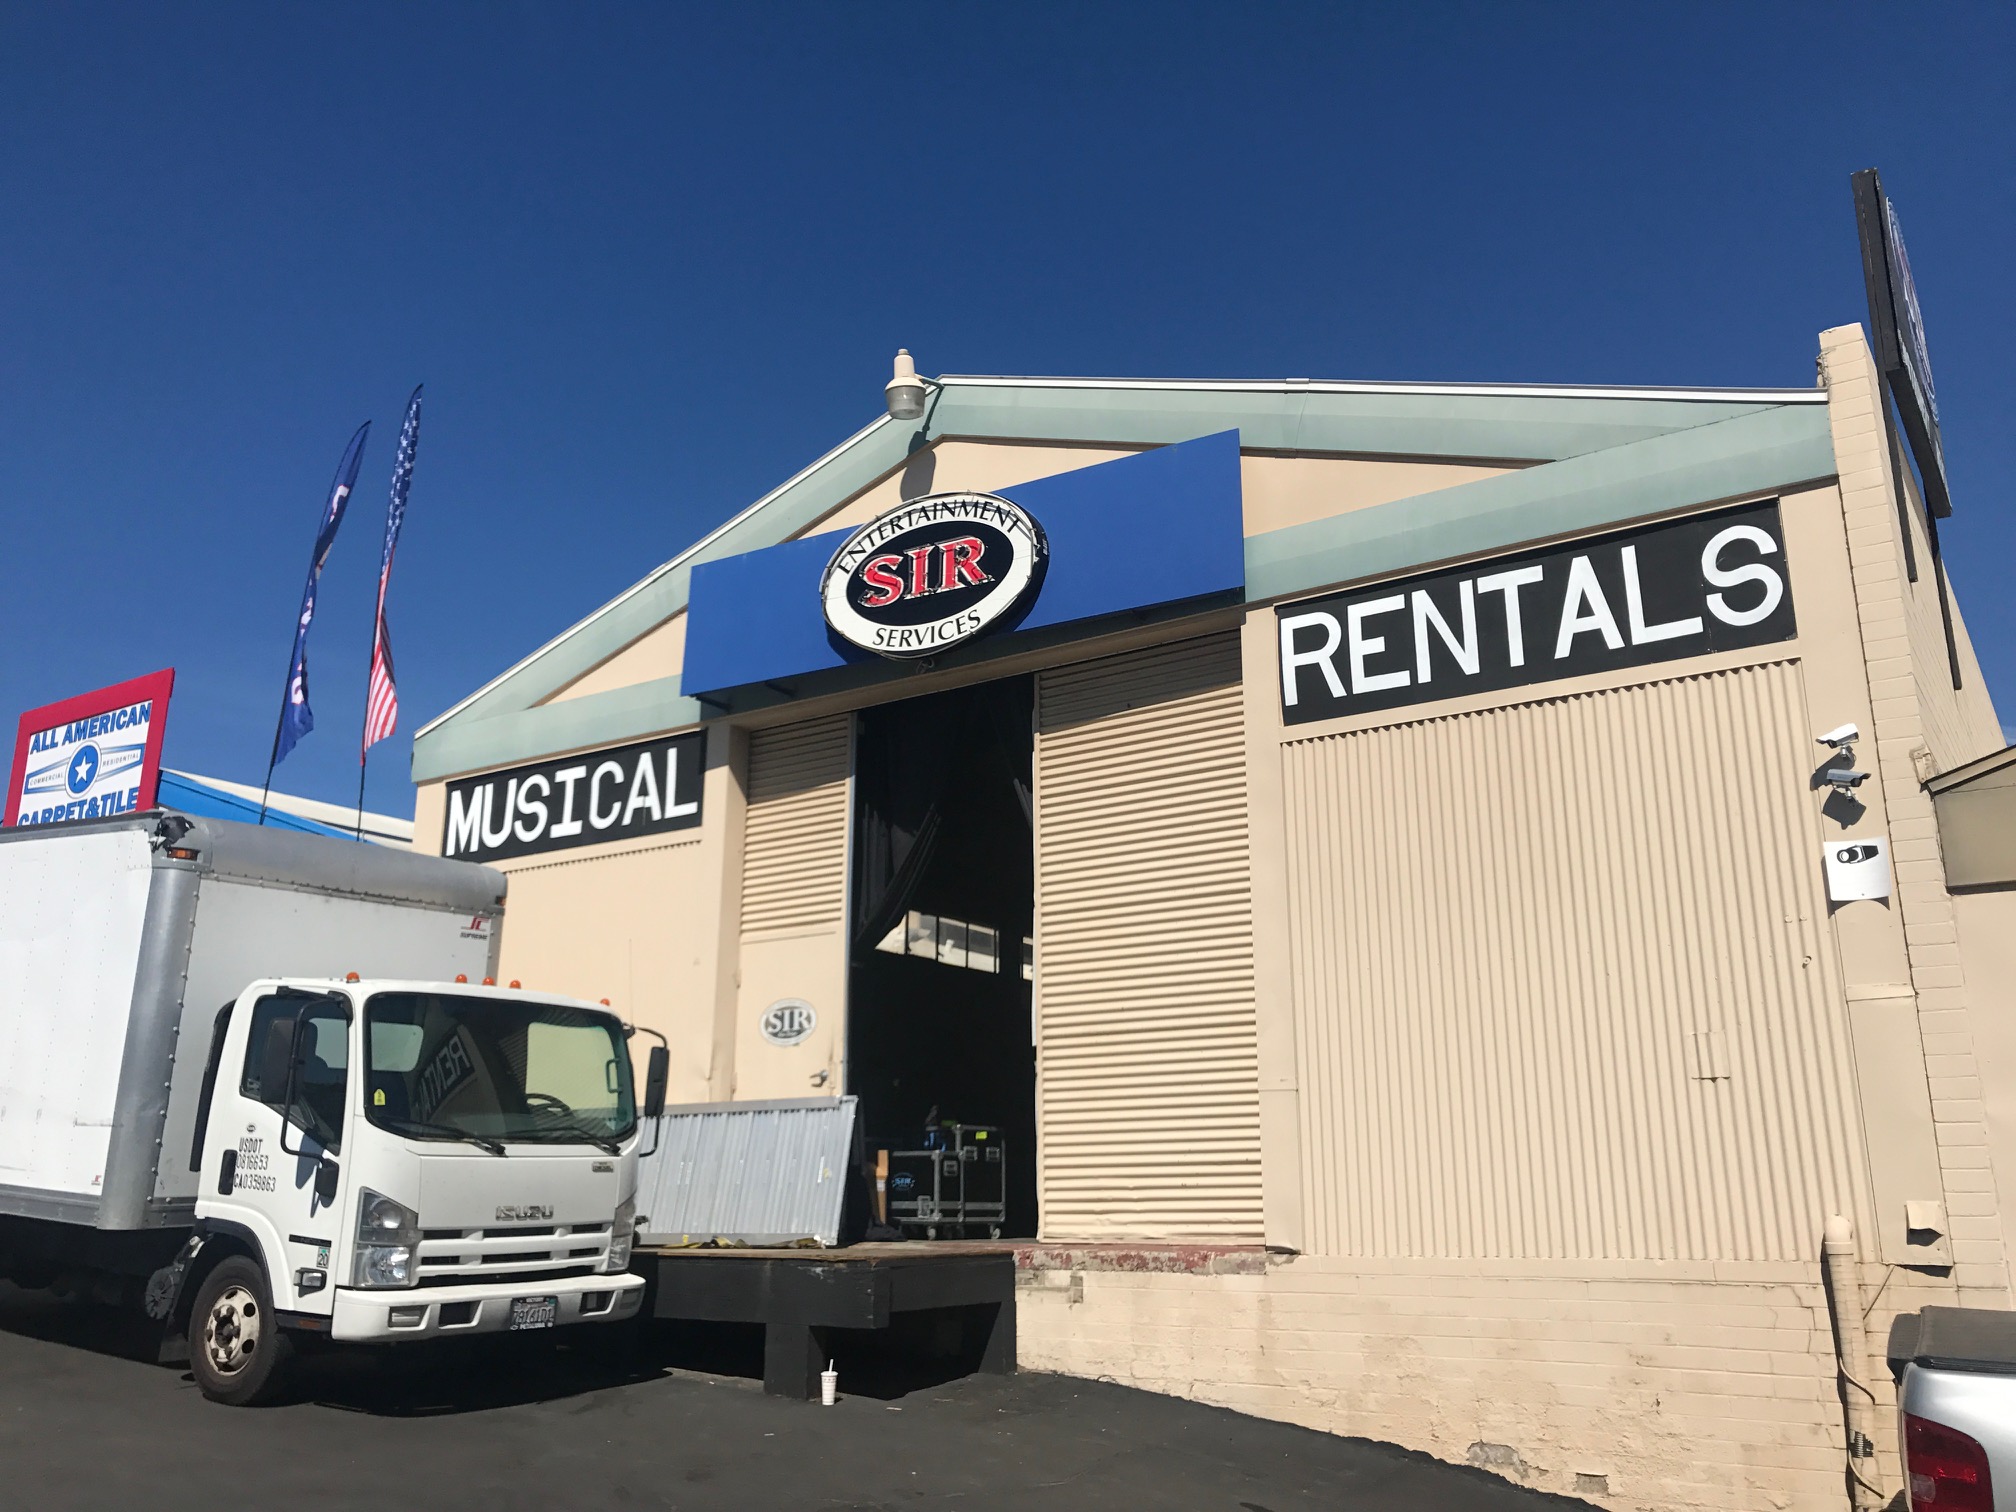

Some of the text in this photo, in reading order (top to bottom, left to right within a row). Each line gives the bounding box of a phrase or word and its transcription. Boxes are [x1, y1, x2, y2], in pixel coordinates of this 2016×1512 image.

[837, 499, 1022, 575] ENTERTAINMENT
[858, 535, 996, 608] SIR
[872, 609, 981, 648] SERVICES
[1280, 525, 1784, 706] RENTALS
[30, 702, 152, 755] ALL AMERICAN
[30, 753, 139, 786] COMMERCIAL RESIDENTIAL
[446, 747, 698, 856] MUSICAL
[767, 1008, 811, 1033] SIR
[239, 1137, 263, 1153] USDOT
[496, 1205, 554, 1221] ISUZU
